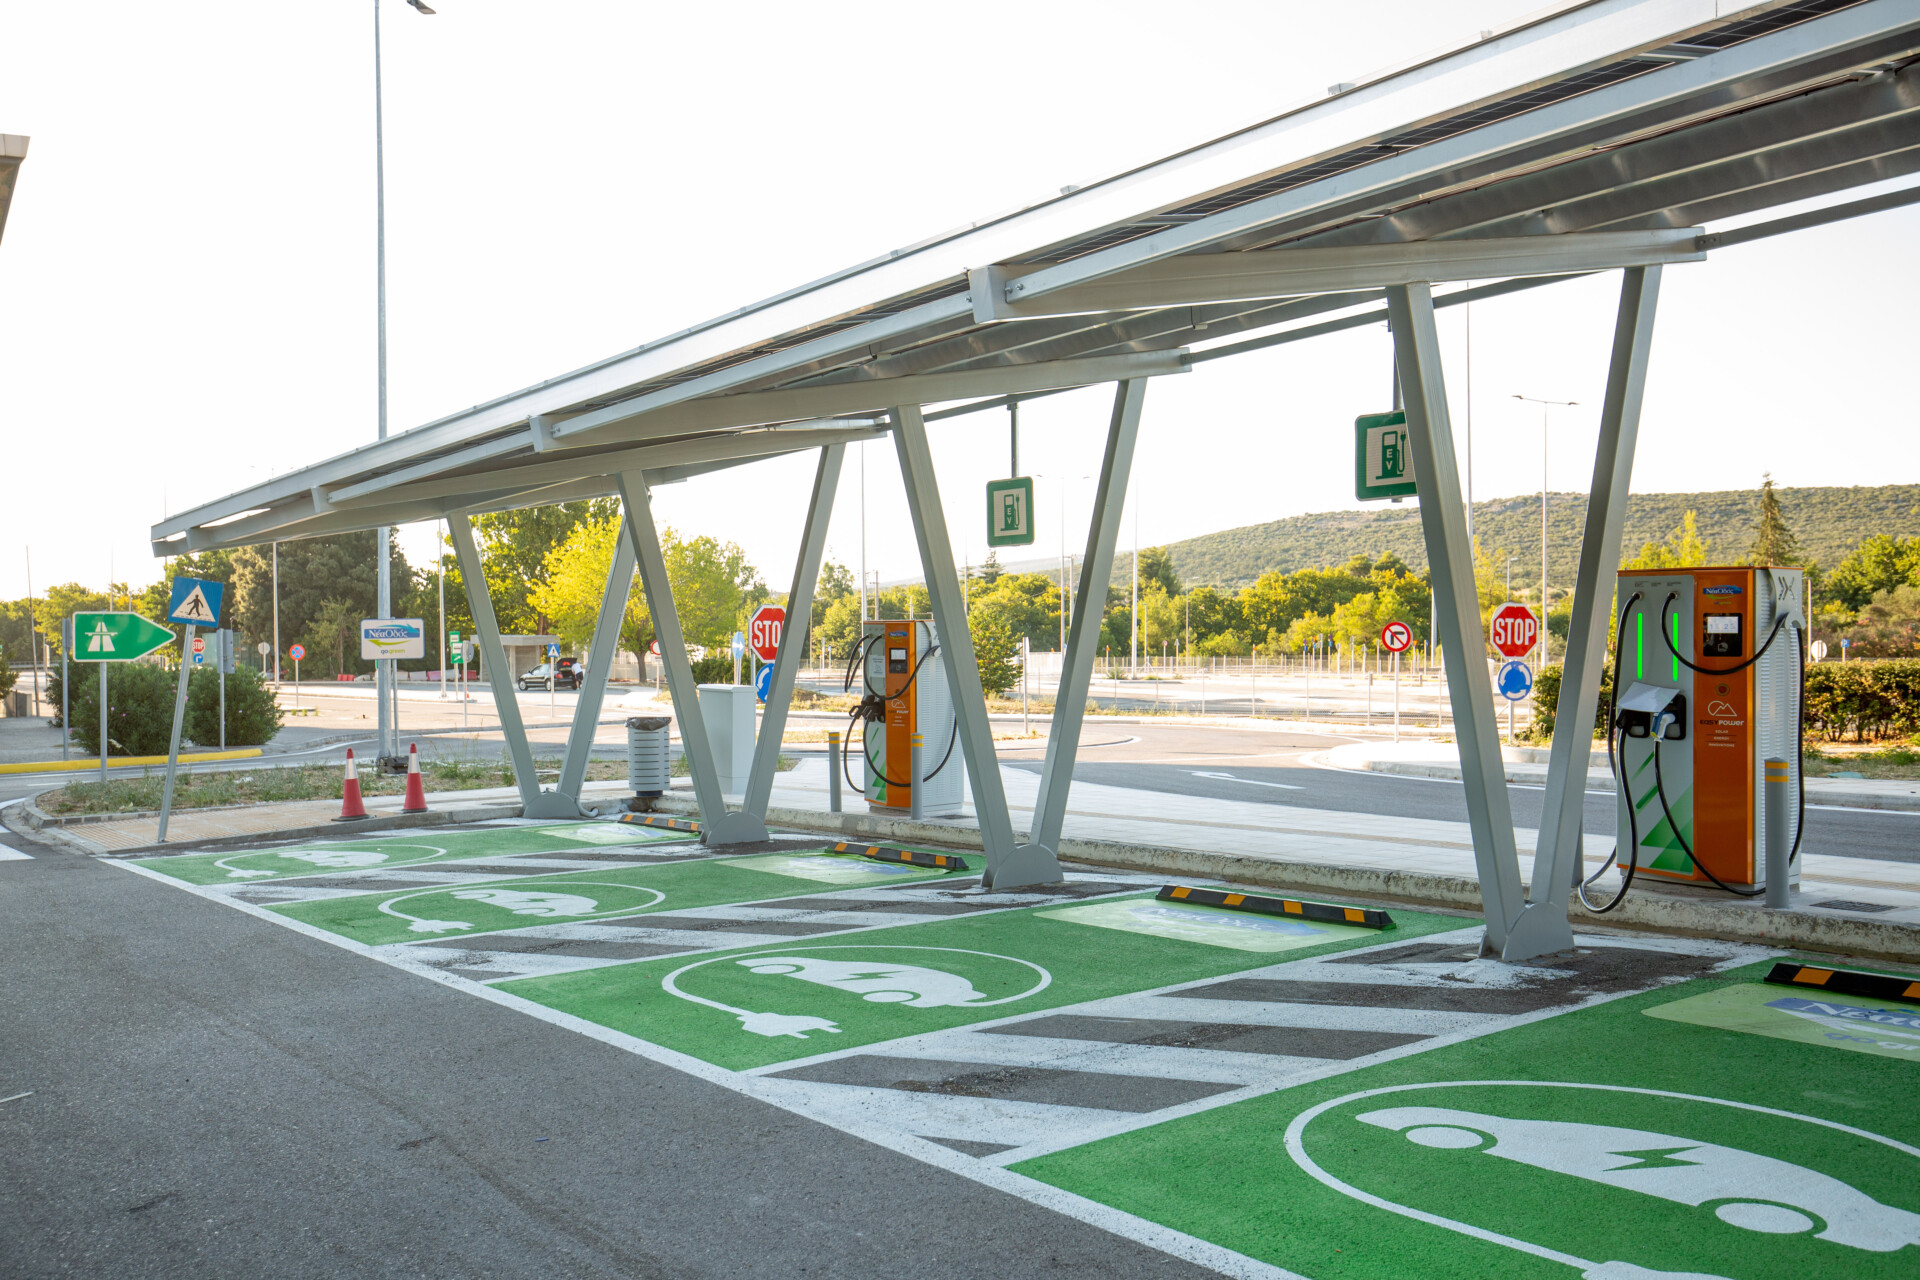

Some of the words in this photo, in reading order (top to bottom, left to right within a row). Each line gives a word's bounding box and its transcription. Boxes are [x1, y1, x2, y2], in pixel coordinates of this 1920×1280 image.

[1386, 448, 1393, 471] EV
[1007, 507, 1012, 525] EV
[754, 620, 785, 648] STO
[1495, 618, 1535, 645] STOP
[1794, 1002, 1920, 1029] Νέα
